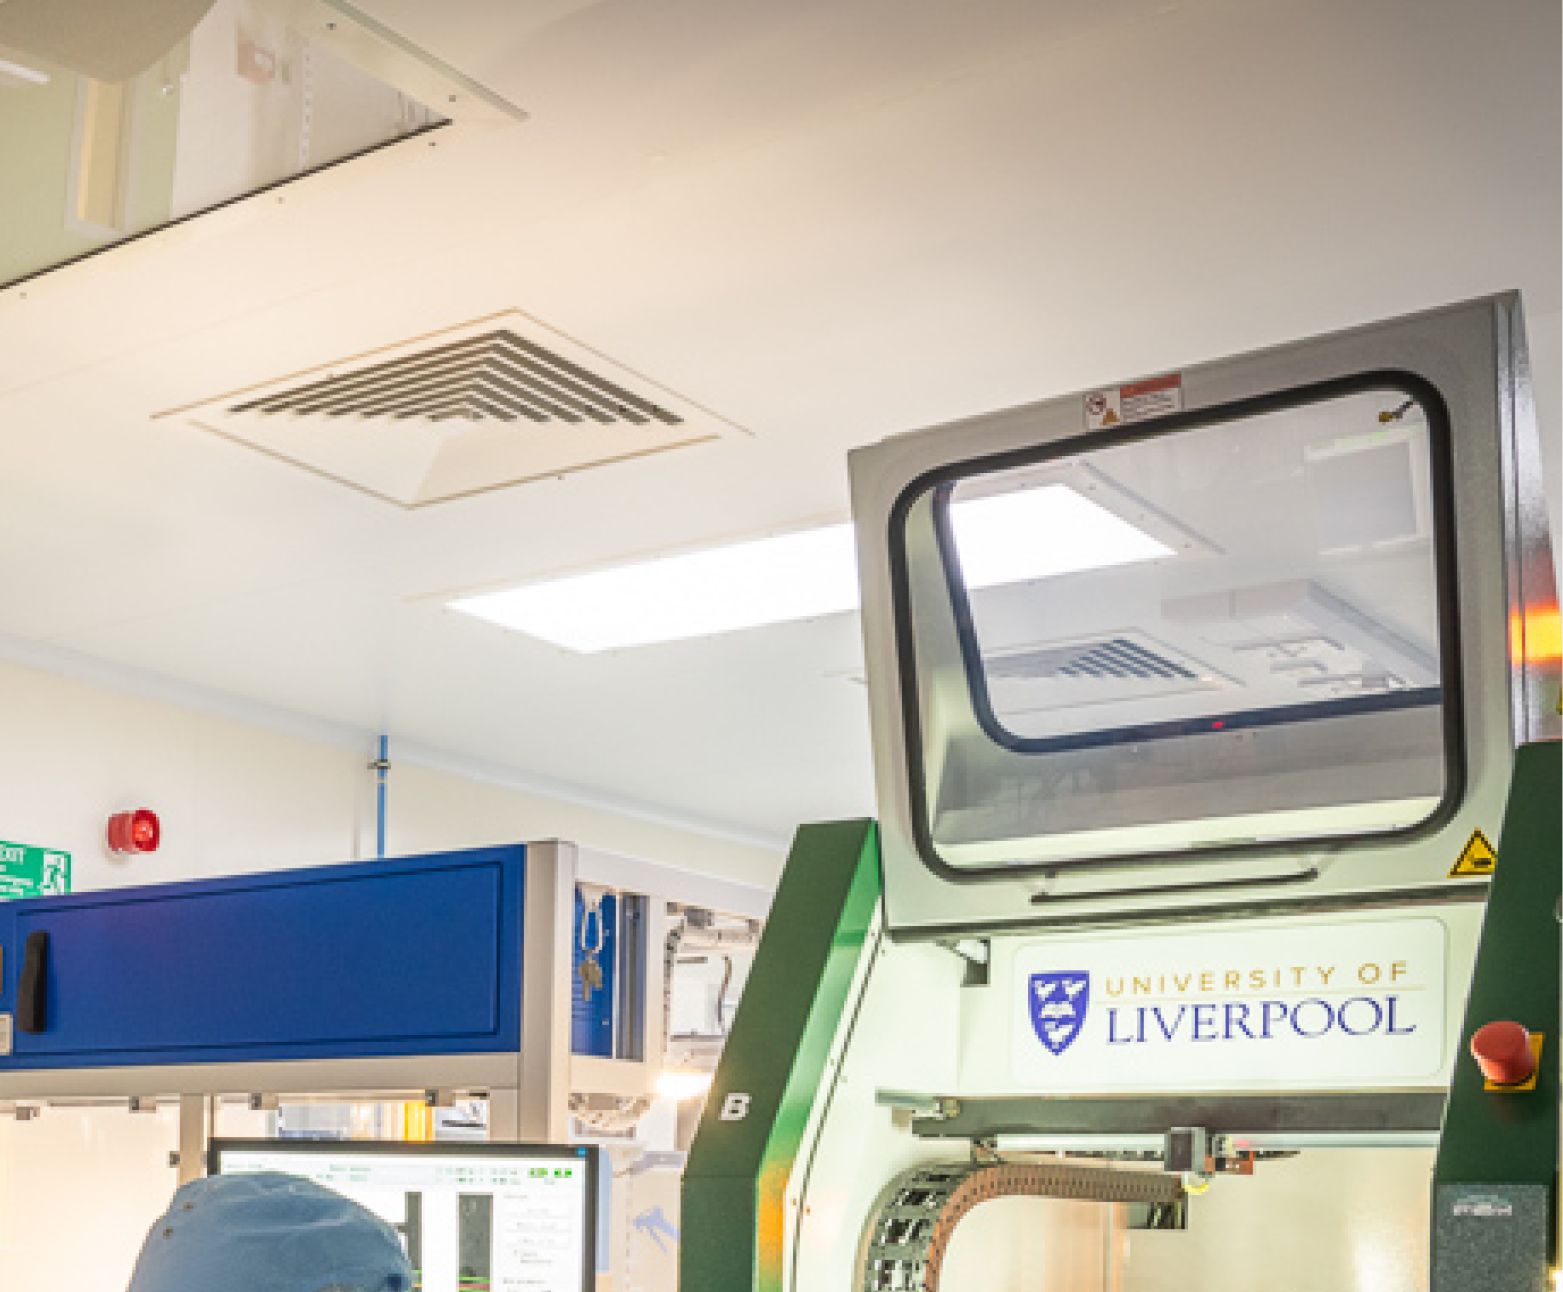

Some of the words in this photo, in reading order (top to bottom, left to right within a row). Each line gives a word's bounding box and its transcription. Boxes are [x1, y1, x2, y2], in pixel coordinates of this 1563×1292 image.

[1105, 965, 1335, 997] UNIVERSITY
[1357, 960, 1408, 985] OF
[1105, 994, 1417, 1044] LIVERPOOL
[719, 1092, 752, 1120] B
